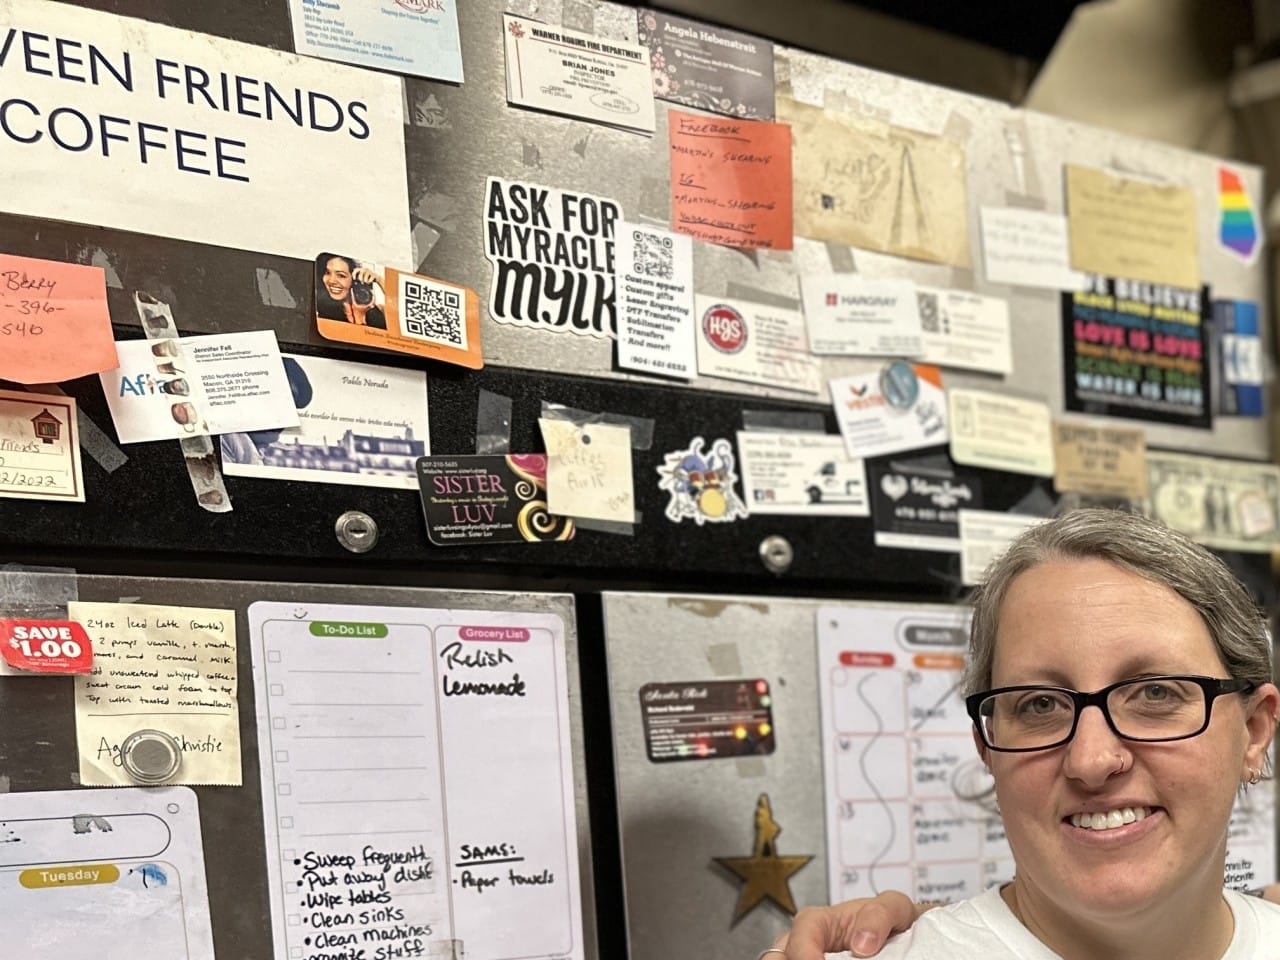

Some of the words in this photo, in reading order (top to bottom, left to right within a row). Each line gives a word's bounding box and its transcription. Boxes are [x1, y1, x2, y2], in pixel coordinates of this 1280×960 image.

[532, 28, 560, 41] WARNER
[561, 35, 586, 48] ROBINS
[587, 41, 600, 52] FIRE
[602, 44, 642, 60] DEPARTMENT
[664, 22, 698, 39] Angela
[700, 31, 757, 54] Hebenstreit
[562, 60, 587, 71] BRIAN
[589, 66, 615, 77] JONES
[156, 58, 370, 140] FRIENDS
[1, 98, 250, 183] COFFEE
[488, 181, 551, 228] ASK
[562, 194, 619, 238] FOR
[488, 221, 615, 274] MYRACLE
[625, 274, 654, 286] Custom
[656, 282, 685, 293] apparel
[625, 285, 654, 296] Custom
[1073, 320, 1125, 347] LOVE
[1129, 329, 1150, 351] IS
[1153, 334, 1202, 360] LOVE
[342, 376, 362, 386] Pablo
[363, 379, 389, 389] Neruda
[1076, 372, 1136, 396] WATER
[433, 474, 507, 495] SISTER
[451, 504, 497, 523] LUV
[13, 626, 72, 640] SAVE
[127, 617, 147, 628] Iced
[322, 624, 354, 635] To-Do
[356, 625, 376, 636] List
[466, 628, 504, 641] Grocery
[505, 630, 524, 640] List
[9, 637, 82, 658] $1.00
[440, 642, 514, 670] Relish
[443, 673, 526, 697] Lemonade
[302, 851, 355, 872] Sweep
[460, 843, 517, 860] SAMS:
[40, 869, 100, 884] Tuesday
[303, 870, 338, 891] Put
[343, 871, 386, 890] away
[461, 870, 500, 893] Paper
[508, 870, 554, 885] towels
[307, 893, 343, 909] Wipe
[349, 890, 392, 905] tables
[311, 912, 355, 929] Clean
[363, 924, 433, 942] machines
[376, 939, 425, 960] stuff
